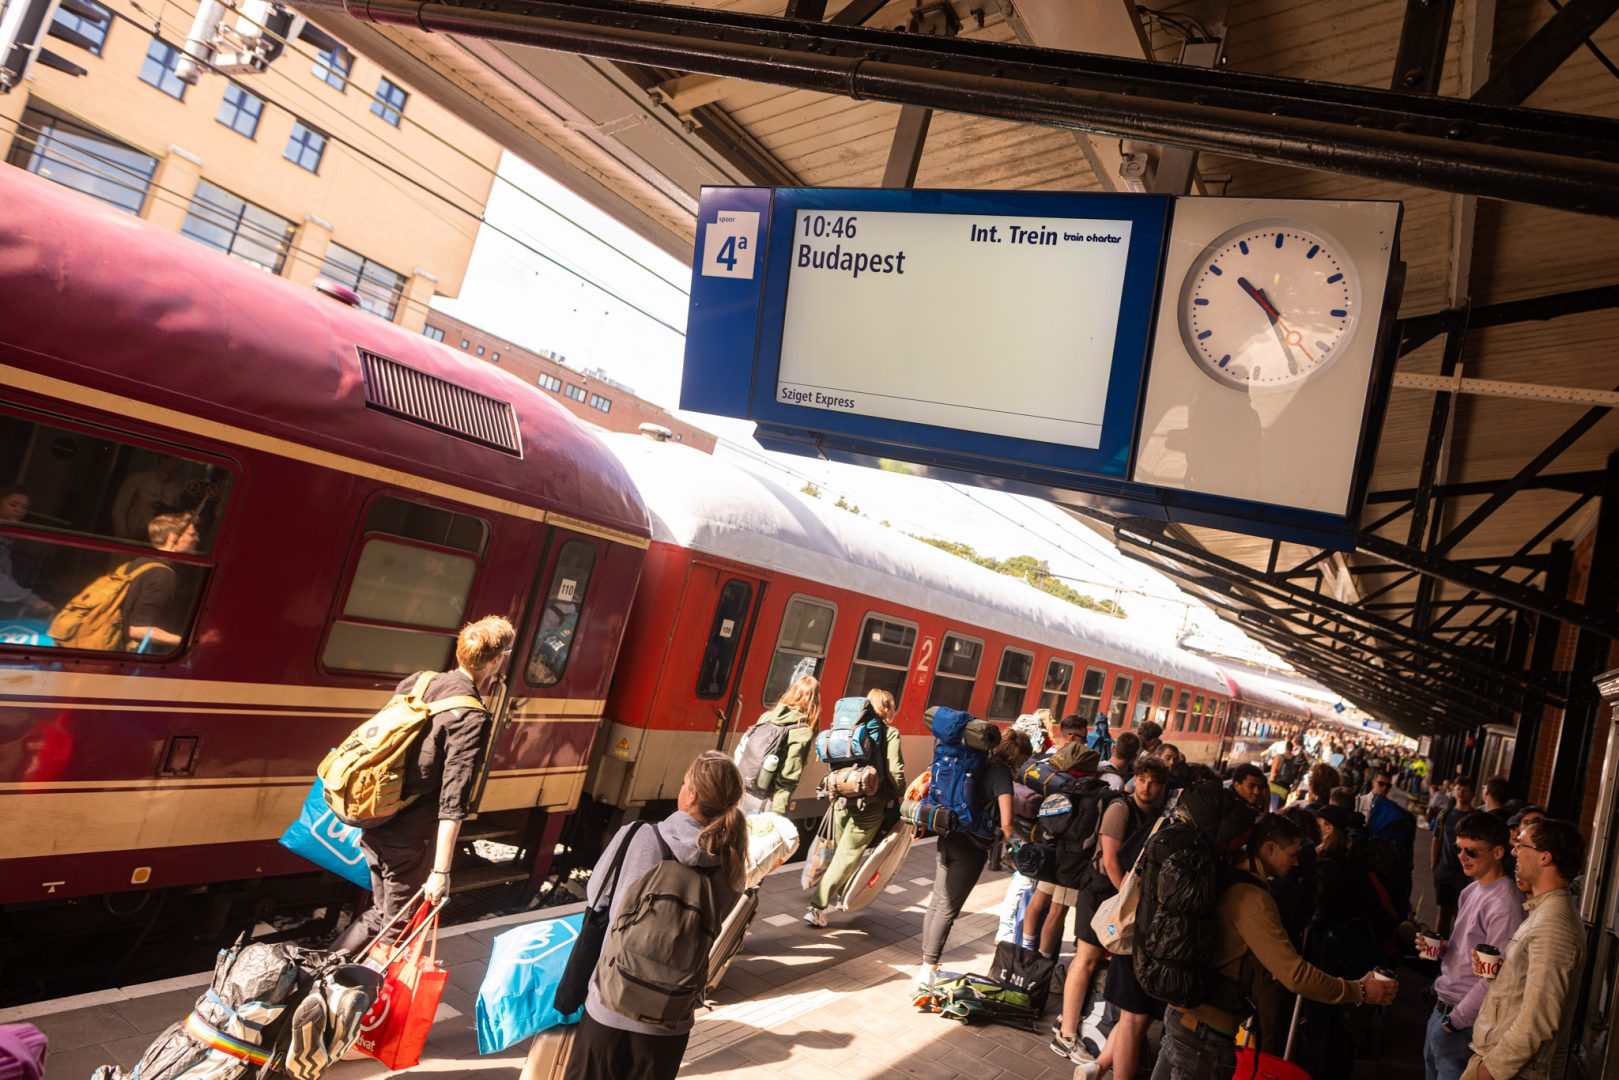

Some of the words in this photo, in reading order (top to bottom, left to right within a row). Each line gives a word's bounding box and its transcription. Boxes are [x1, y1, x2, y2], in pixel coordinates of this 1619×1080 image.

[803, 215, 857, 239] 10:46
[970, 224, 1002, 243] Int.
[1009, 225, 1058, 246] Trein
[1063, 232, 1084, 242] train
[1086, 233, 1122, 243] charter
[798, 244, 906, 278] Budapest
[782, 387, 813, 403] Sziget
[815, 392, 855, 408] Express
[561, 584, 574, 596] 110
[917, 639, 933, 671] 2
